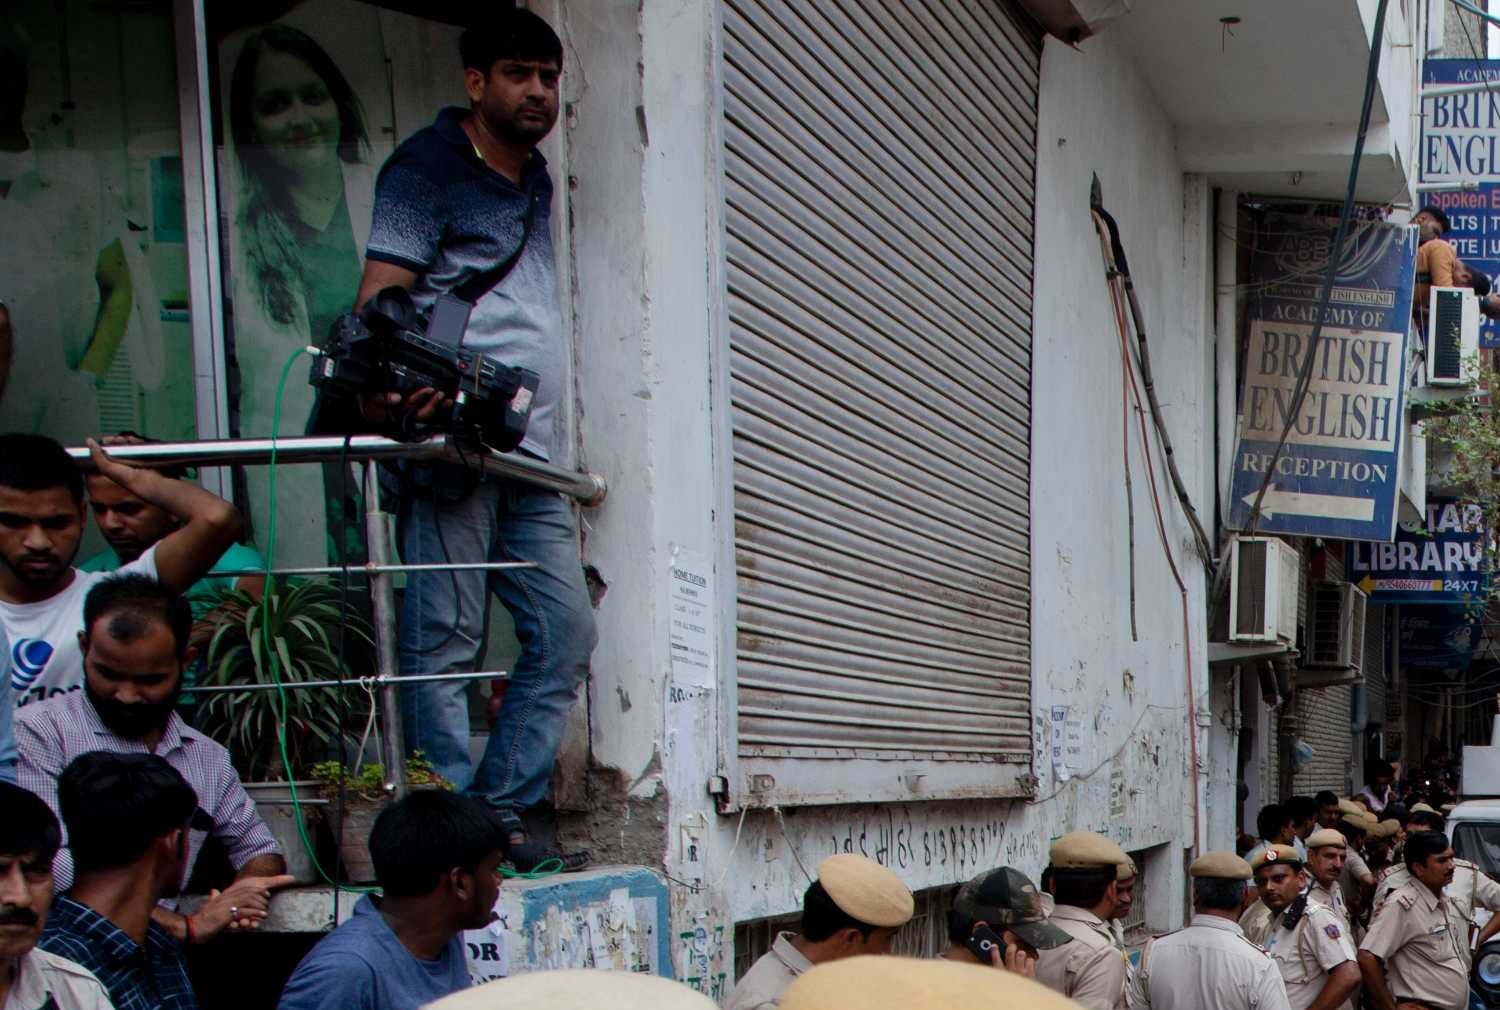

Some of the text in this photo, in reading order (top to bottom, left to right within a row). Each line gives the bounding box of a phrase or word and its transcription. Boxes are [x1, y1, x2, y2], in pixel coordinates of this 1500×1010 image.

[1432, 190, 1487, 213] Spoken
[1449, 216, 1478, 230] LTS
[1272, 304, 1385, 328] ACADEMY OF
[1259, 331, 1393, 386] BRITISH
[1248, 385, 1394, 442] ENGLISH
[1242, 452, 1389, 483] RECEPTION
[1352, 541, 1483, 572] LIBRARY
[1444, 580, 1479, 592] 24X7
